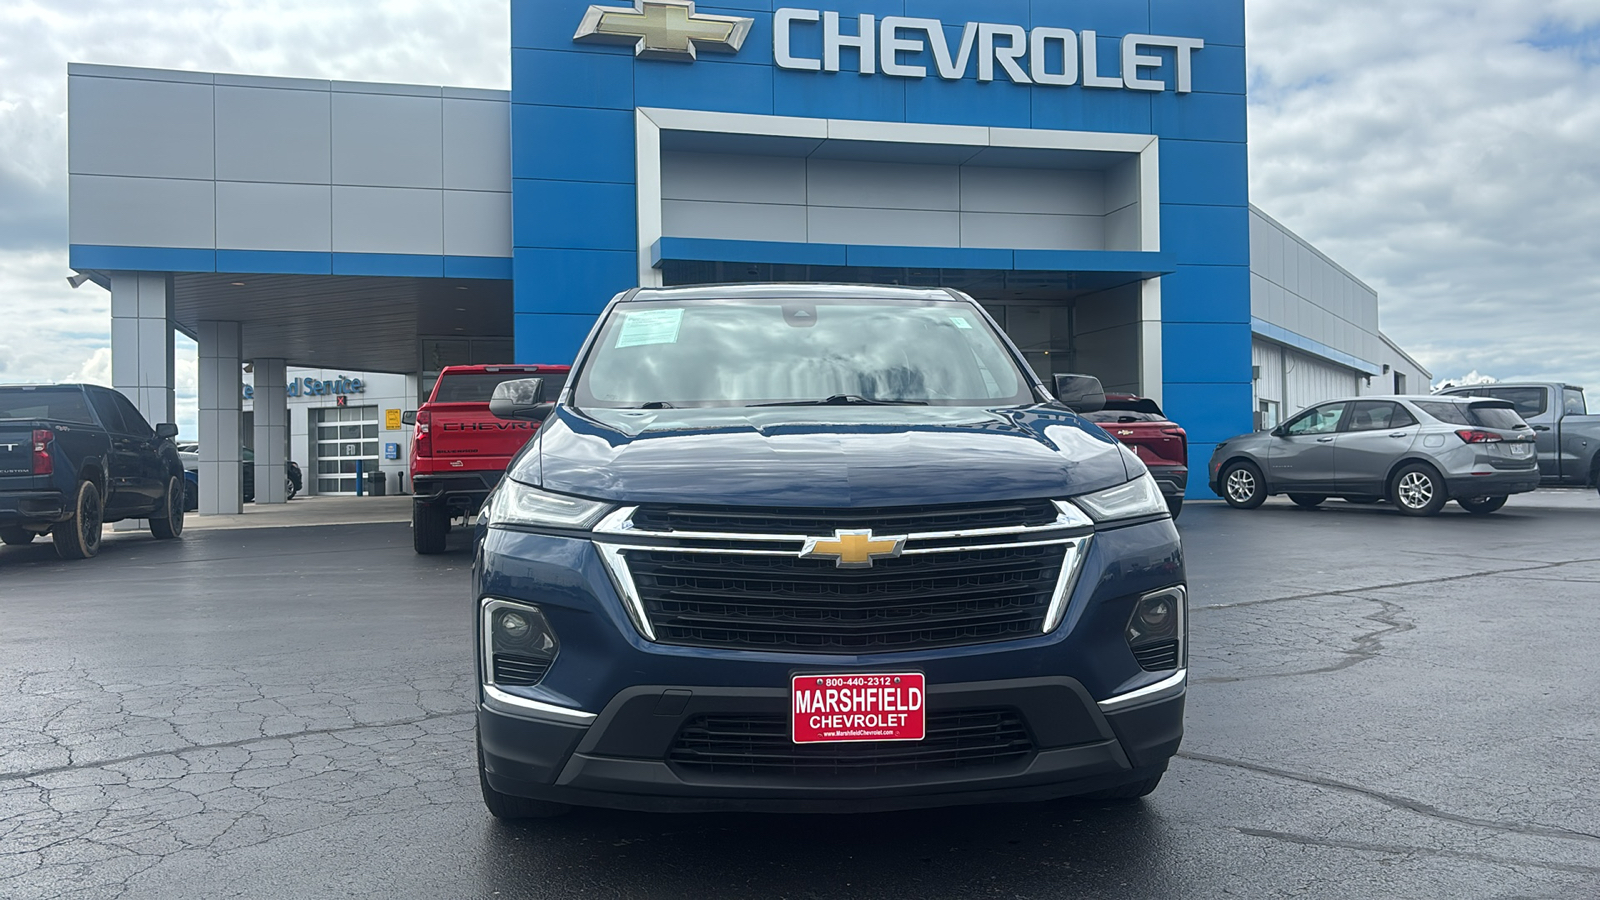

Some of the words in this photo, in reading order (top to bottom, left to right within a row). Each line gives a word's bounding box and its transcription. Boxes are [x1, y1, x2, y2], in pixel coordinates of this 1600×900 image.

[773, 7, 1204, 93] CHEVROLET
[303, 375, 361, 395] Service
[825, 677, 891, 687] 800-440-2312
[796, 687, 922, 714] MARSHFIELD
[809, 714, 908, 728] CHEVROLET
